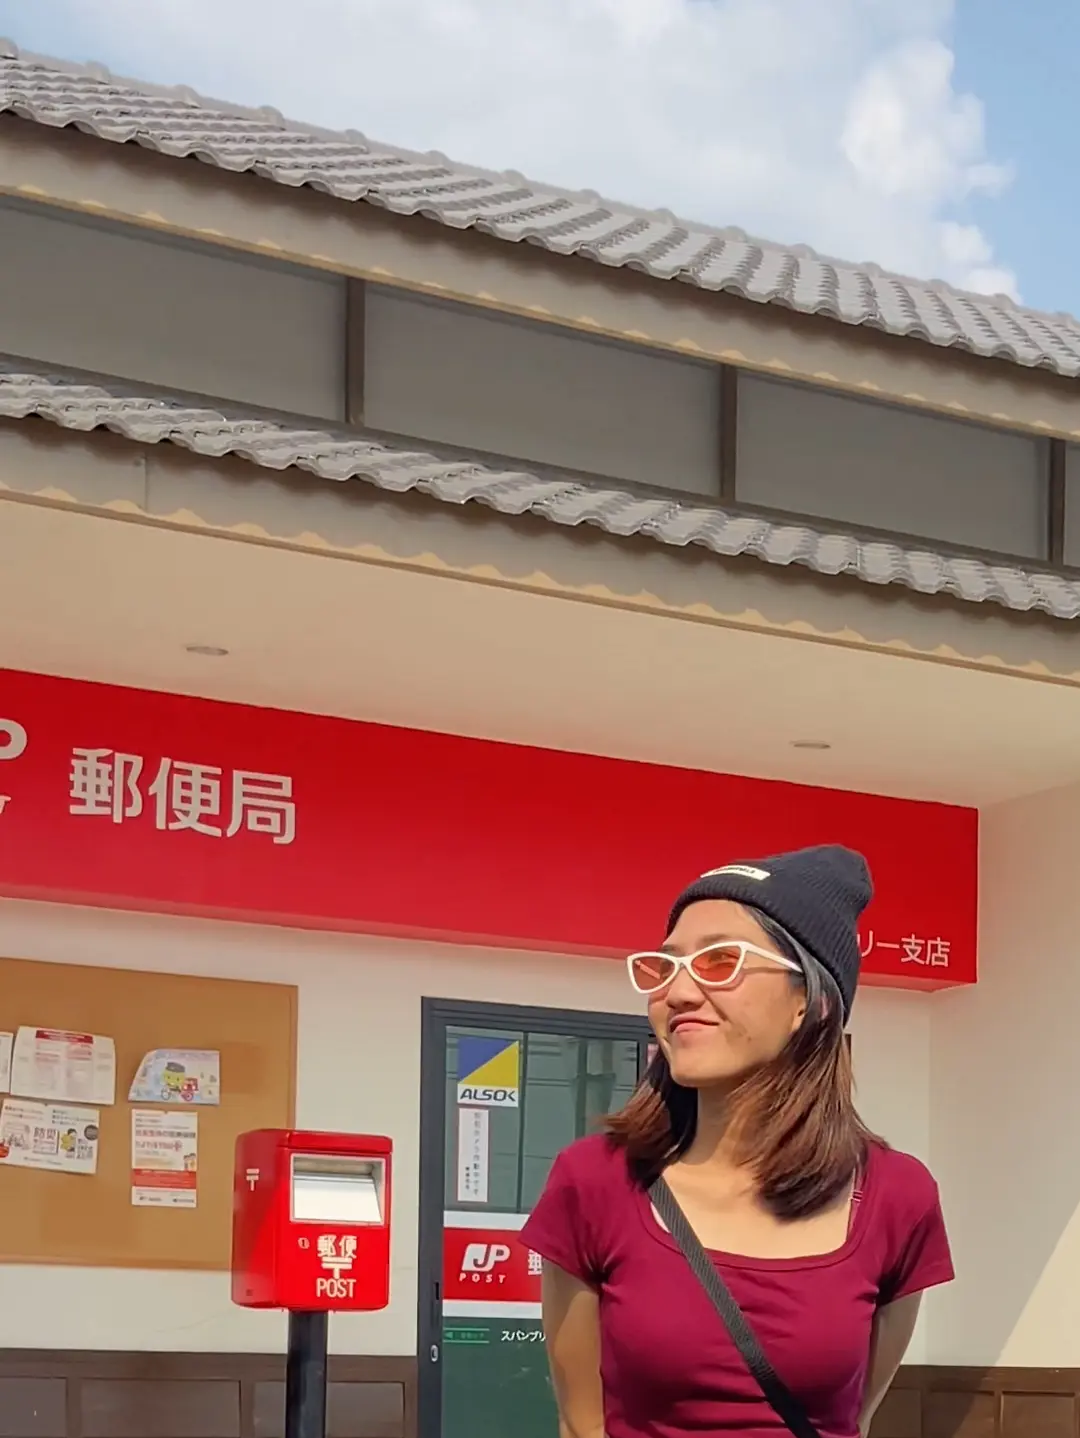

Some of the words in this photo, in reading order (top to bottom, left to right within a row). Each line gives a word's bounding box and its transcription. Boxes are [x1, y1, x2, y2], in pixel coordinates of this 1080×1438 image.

[69, 747, 297, 845] 郵便局
[460, 1088, 516, 1102] ALSOK
[317, 1234, 358, 1259] 郵便
[316, 1277, 357, 1299] POST
[458, 1273, 506, 1284] POST
